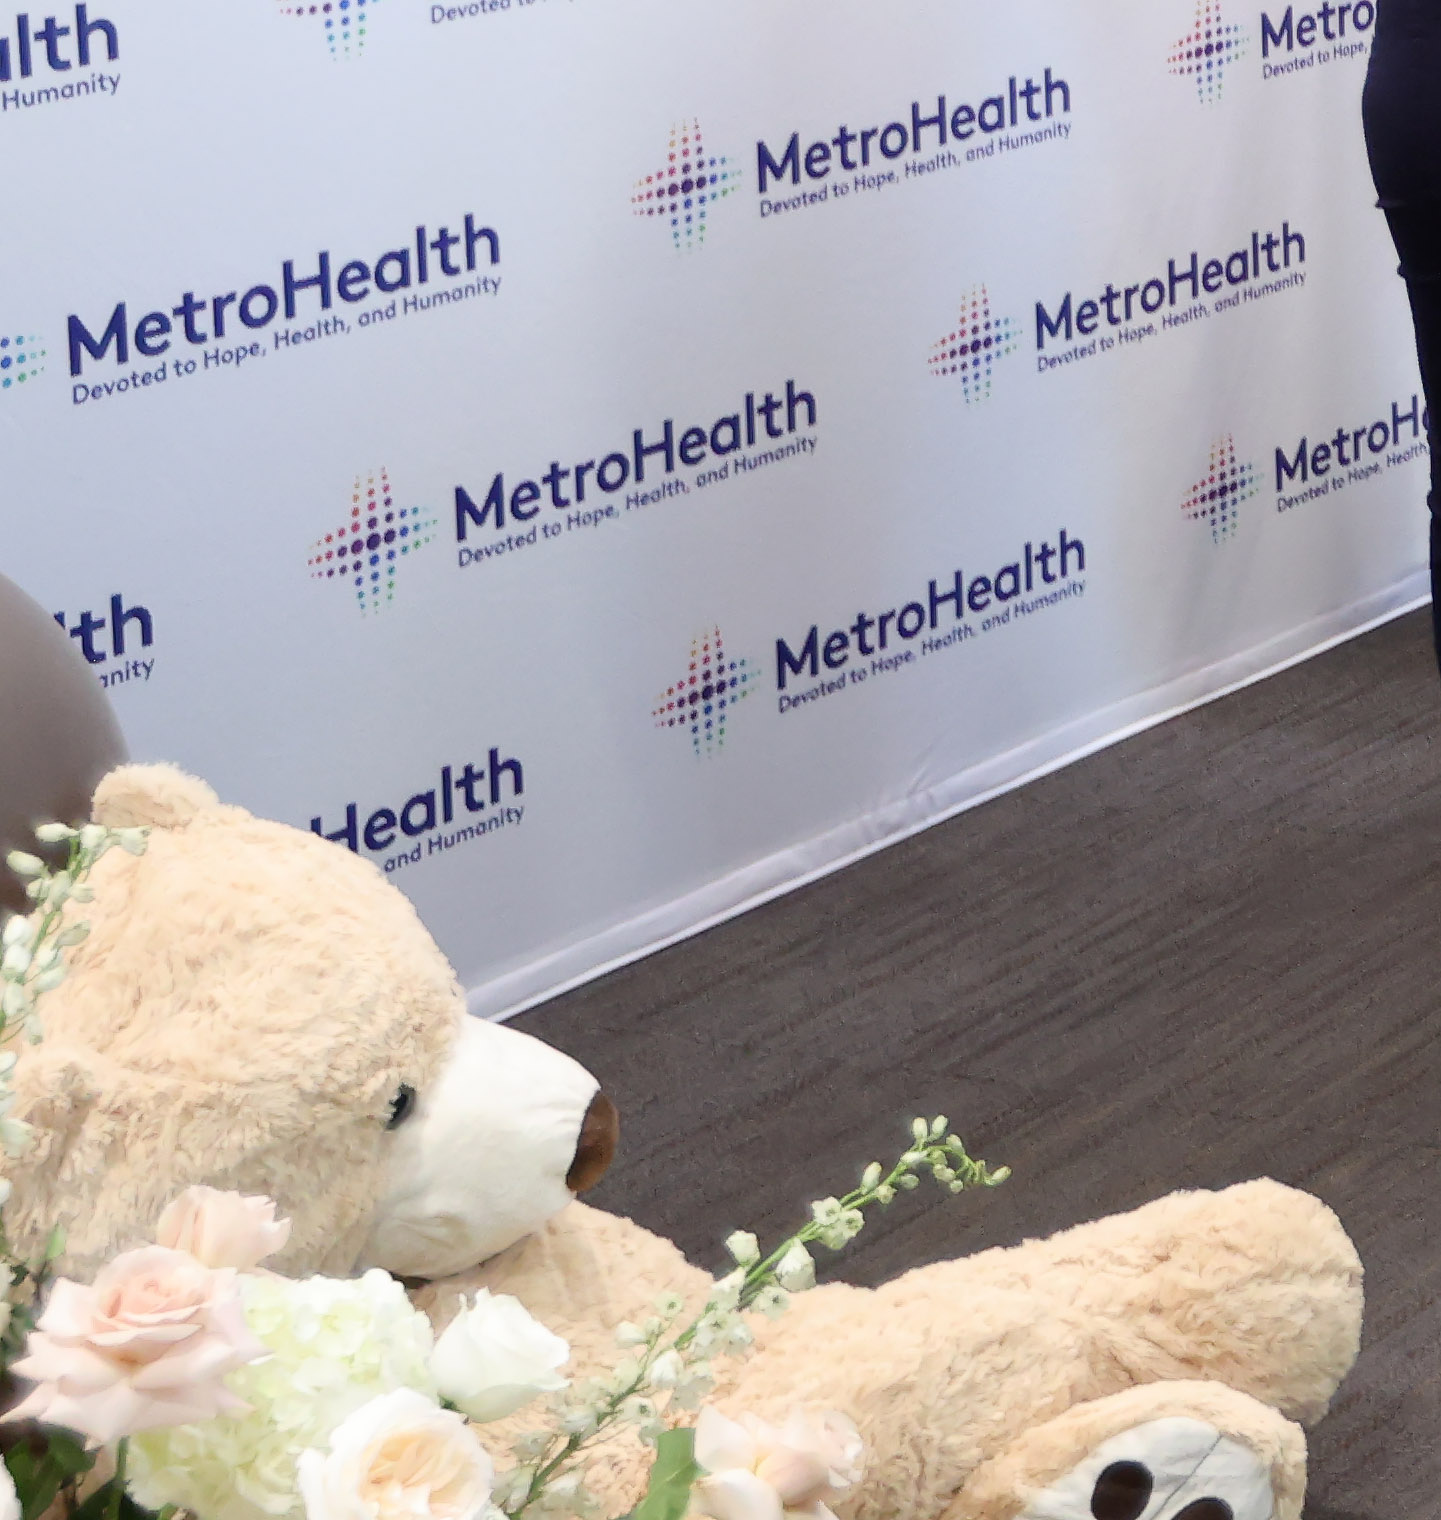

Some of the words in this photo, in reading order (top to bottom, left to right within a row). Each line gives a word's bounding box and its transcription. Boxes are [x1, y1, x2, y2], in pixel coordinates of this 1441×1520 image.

[2, 73, 121, 112] Humanity
[1262, 50, 1314, 80] Devoted
[1317, 50, 1330, 64] to
[1333, 42, 1368, 59] Hope,
[756, 67, 1071, 194] MetroHealth
[759, 183, 828, 218] Devoted
[831, 182, 850, 198] to
[853, 170, 899, 194] Hope,
[904, 150, 961, 179] Health,
[965, 138, 995, 162] and
[998, 121, 1072, 153] Humanity
[67, 213, 500, 378] MetroHealth
[72, 361, 167, 405] Devoted
[173, 359, 198, 378] to
[203, 342, 266, 370] Hope,
[273, 315, 351, 351] Health,
[357, 299, 397, 328] and
[402, 276, 502, 316] Humanity
[1035, 221, 1306, 351] MetroHealth
[1037, 338, 1097, 373] Devoted
[1099, 336, 1115, 353] to
[1214, 290, 1240, 313] and
[1242, 271, 1307, 303] Humanity
[454, 379, 817, 544] MetroHealth
[458, 524, 537, 569] Devoted
[541, 522, 562, 539] to
[566, 504, 620, 532] Hope,
[625, 478, 690, 511] Health,
[695, 460, 729, 488] and
[733, 436, 818, 476] Humanity
[775, 528, 1086, 691] MetroHealth
[310, 746, 524, 854] Health
[384, 842, 421, 873] and
[428, 805, 524, 857] Humanity
